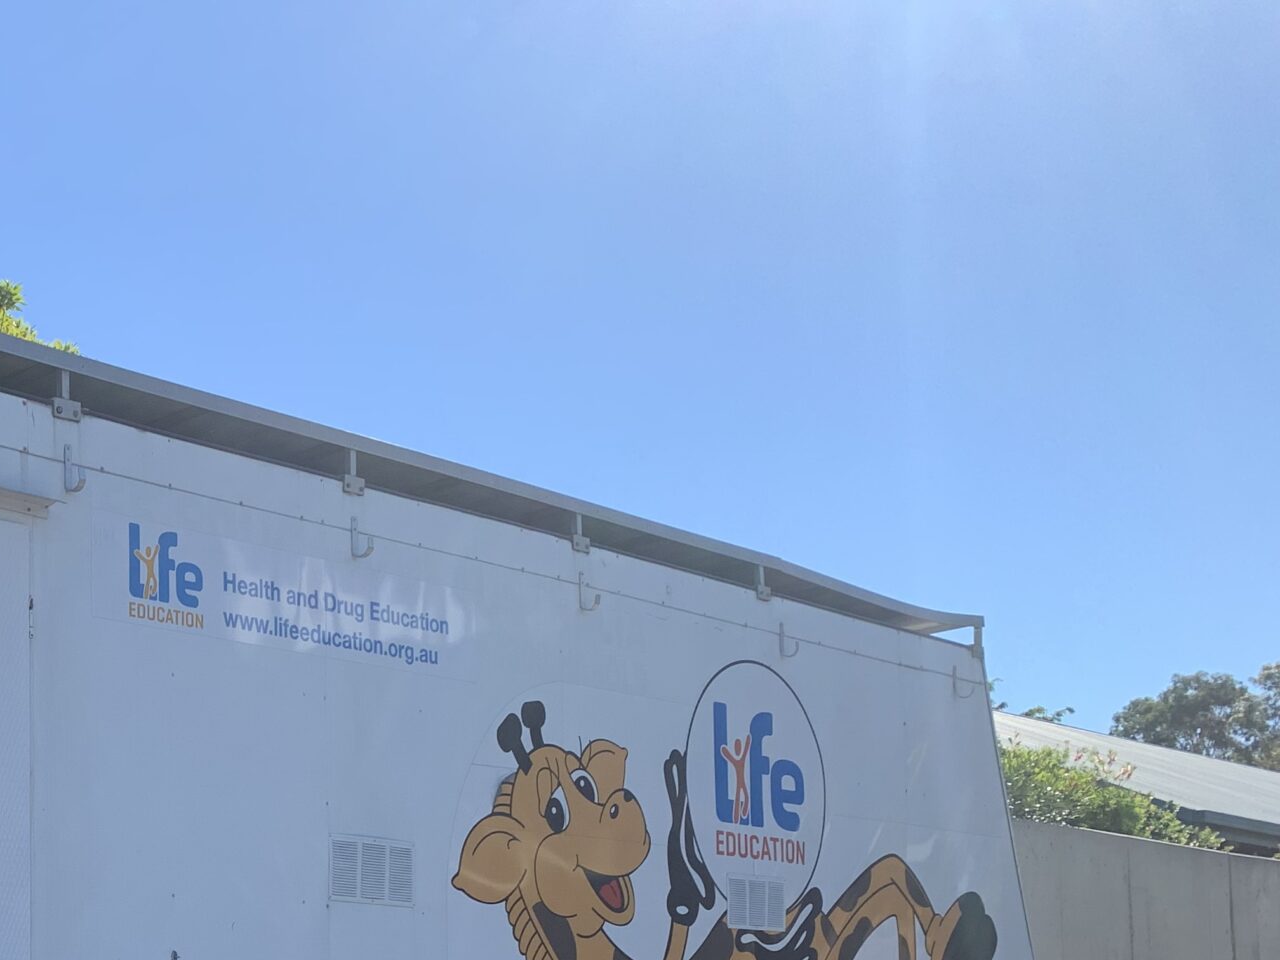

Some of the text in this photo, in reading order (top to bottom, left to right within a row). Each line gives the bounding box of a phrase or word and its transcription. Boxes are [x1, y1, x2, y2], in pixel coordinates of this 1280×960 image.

[128, 601, 204, 630] EDUCATION
[223, 571, 450, 635] Health and Drug Education
[222, 610, 440, 666] www.lifeeducation.org.au
[715, 830, 806, 866] EDUCATION
